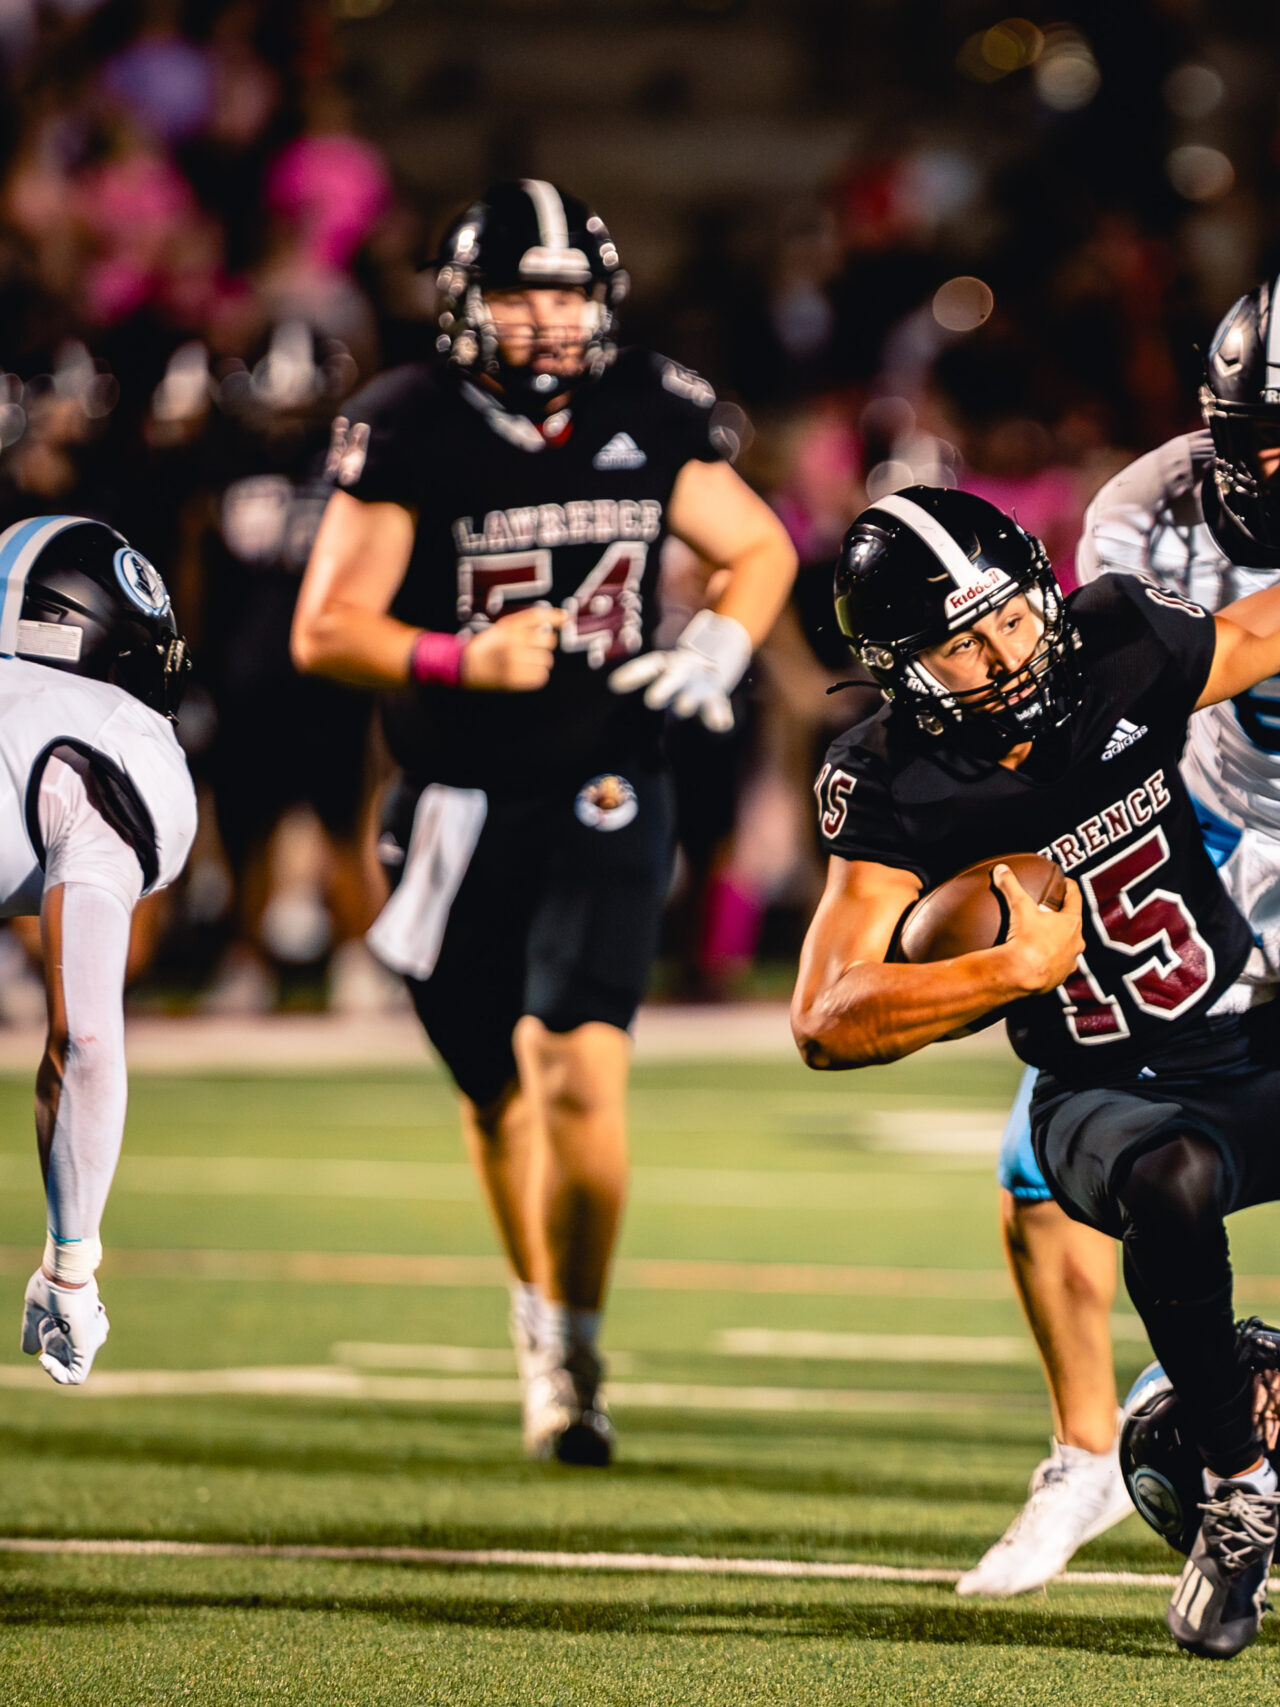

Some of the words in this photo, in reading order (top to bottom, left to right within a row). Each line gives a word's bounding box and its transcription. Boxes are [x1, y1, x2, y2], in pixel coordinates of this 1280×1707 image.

[452, 499, 662, 555] LAWRENCE
[456, 541, 650, 670] 54
[1101, 725, 1149, 762] adidas
[1053, 824, 1216, 1046] 15
